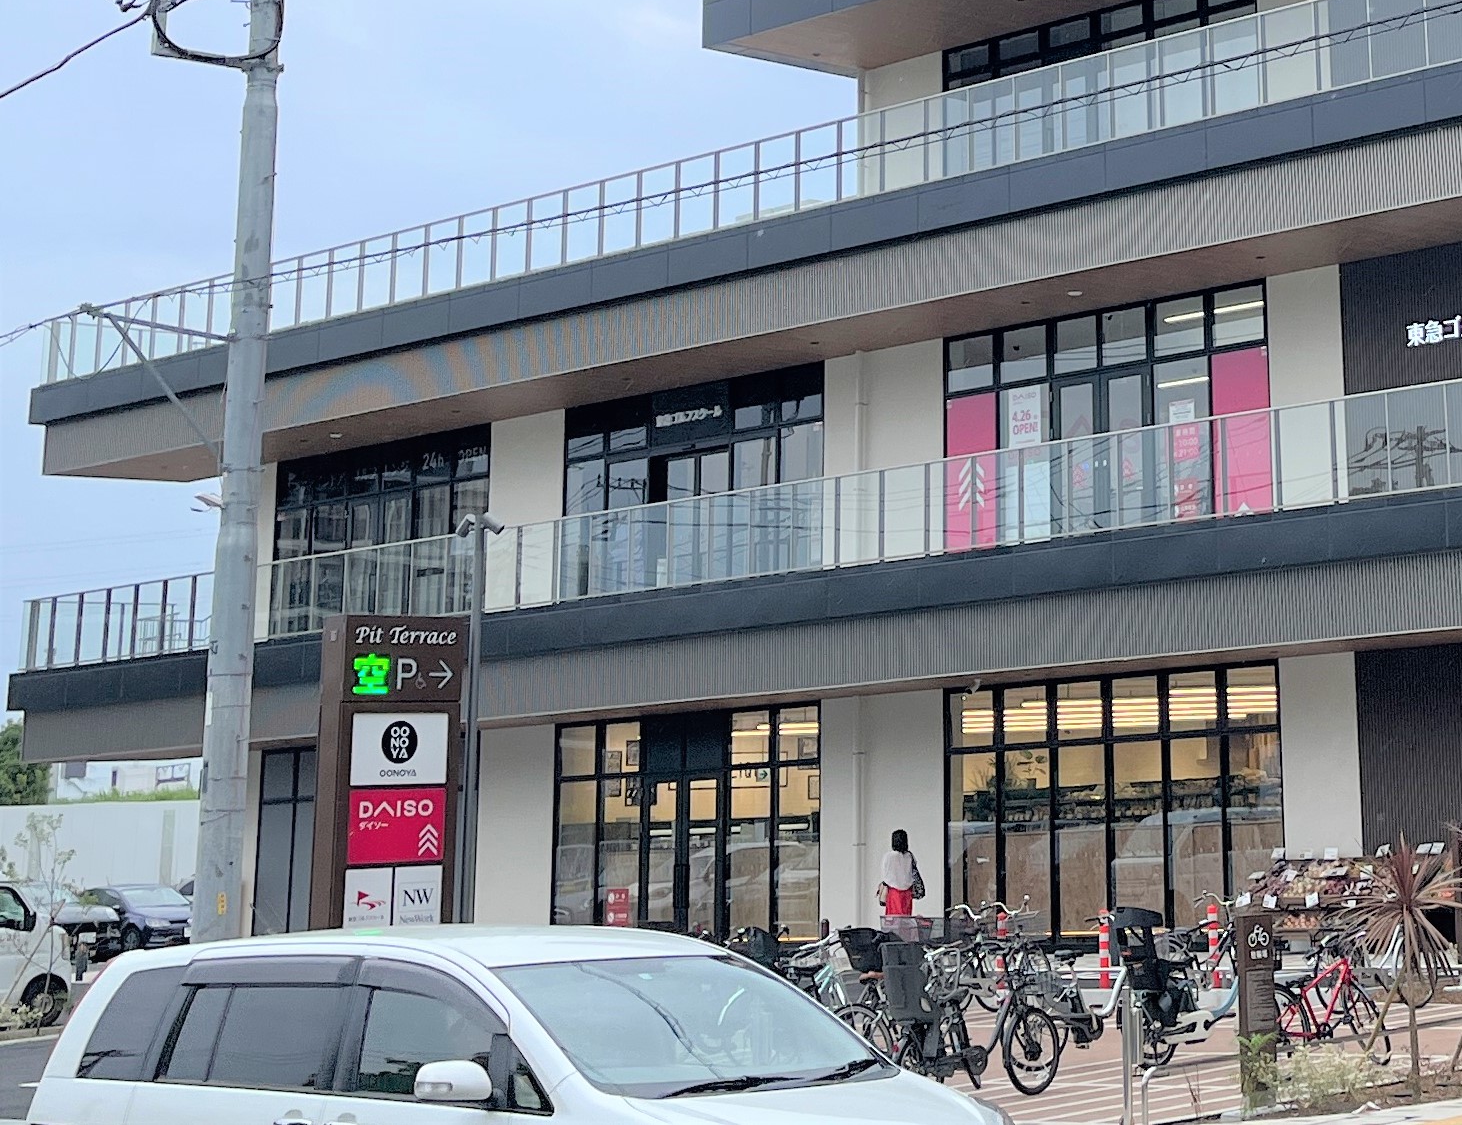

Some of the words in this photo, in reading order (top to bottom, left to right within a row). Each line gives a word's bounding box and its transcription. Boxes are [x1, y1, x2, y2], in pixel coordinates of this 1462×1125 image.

[1012, 409, 1031, 422] 4.26
[355, 625, 383, 644] Pit
[390, 625, 457, 645] Terrace
[352, 653, 390, 695] 空
[396, 658, 418, 690] P
[379, 769, 417, 777] OONOYA
[359, 799, 434, 818] DAISO
[359, 820, 389, 830] ダイソー
[402, 887, 434, 907] NW
